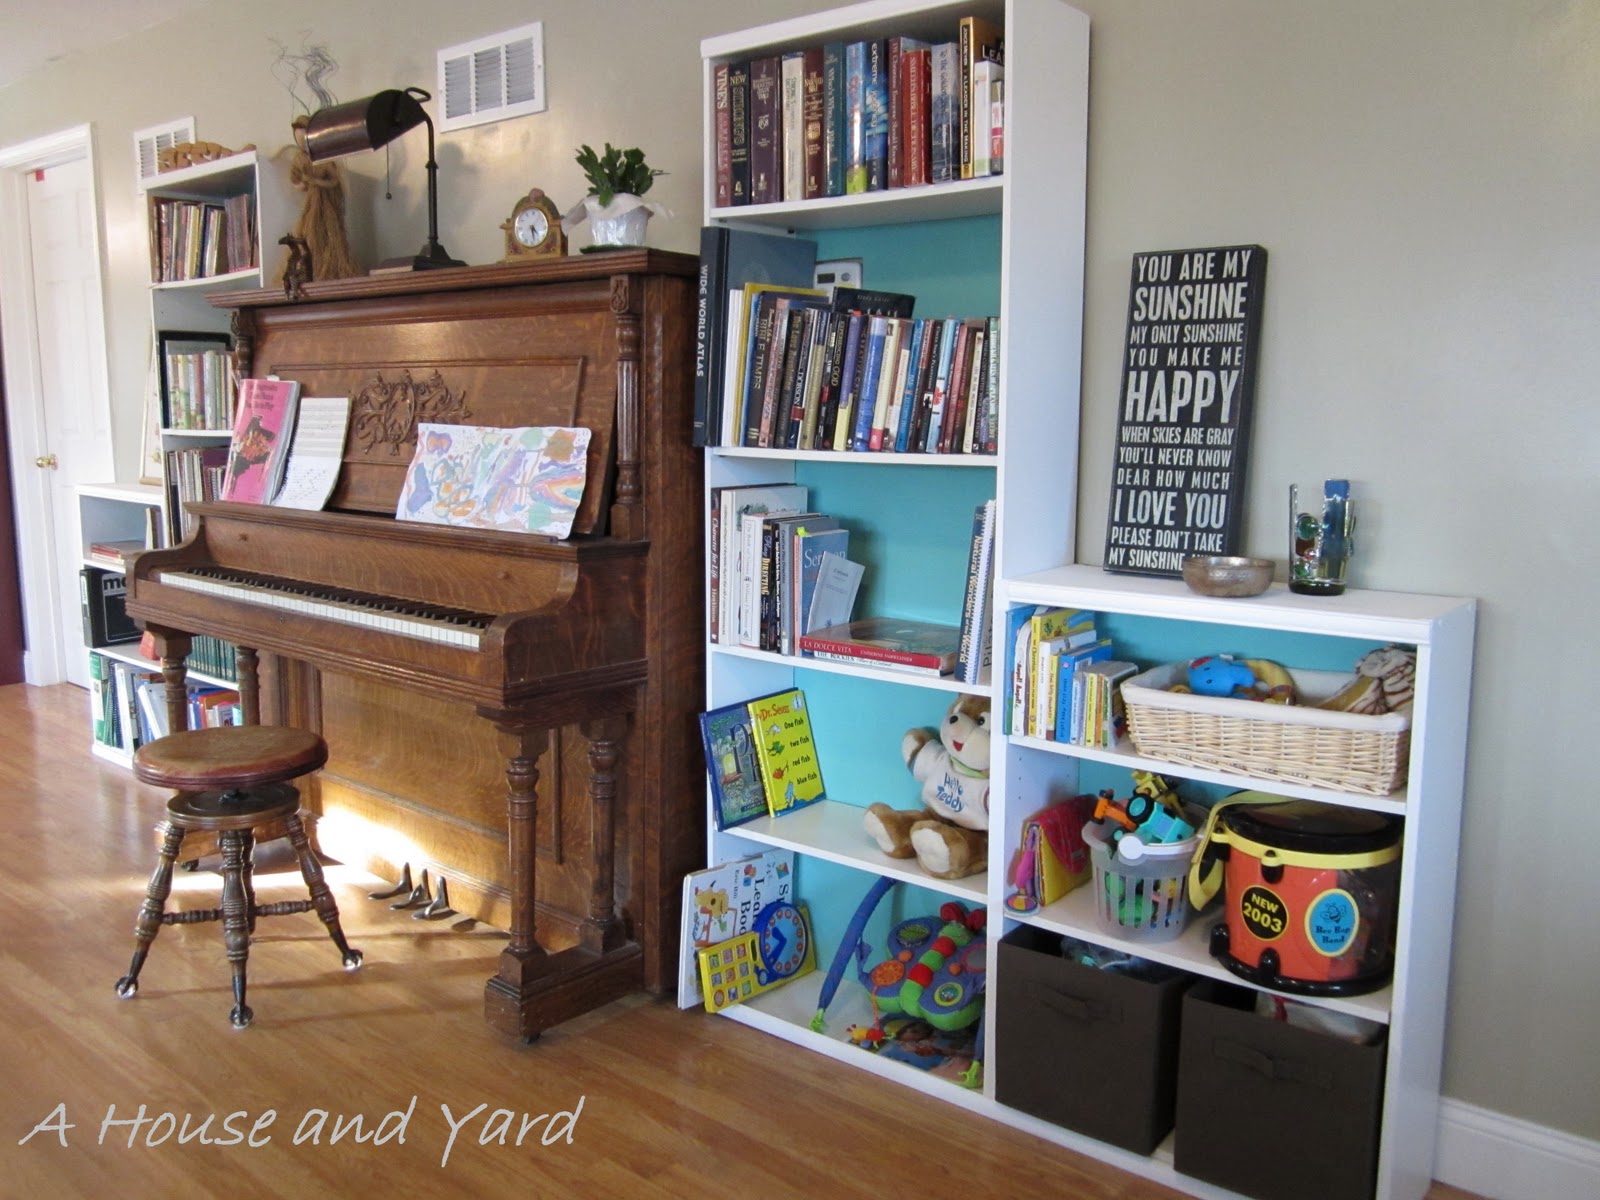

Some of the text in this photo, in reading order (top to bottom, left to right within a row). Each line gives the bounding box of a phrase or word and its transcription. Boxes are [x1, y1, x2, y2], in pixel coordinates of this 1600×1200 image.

[871, 43, 879, 86] extreme
[716, 68, 728, 110] VINE'S
[730, 74, 747, 86] NEW
[870, 90, 881, 129] journey
[891, 90, 899, 120] Everyone
[963, 111, 969, 119] IN
[1138, 249, 1252, 282] YOU ARE MY
[1133, 282, 1248, 322] SUNSHINE
[696, 265, 708, 377] WIDE WORLD ATLAS
[1130, 322, 1244, 345] MY ONLY SUNSHINE
[757, 319, 767, 350] BIBLE
[790, 330, 800, 348] Love
[831, 321, 845, 387] EXPERIENCING GOD
[1129, 346, 1242, 367] YOU MAKE ME
[753, 354, 764, 389] TIMES
[784, 351, 798, 391] Revolution
[794, 370, 804, 405] DOBSON
[1124, 370, 1240, 424] HAPPY
[1121, 426, 1234, 446] WHEN SKIES ARE GRAY
[1119, 447, 1232, 468] YOU'LL NEVER KNOW
[1117, 468, 1230, 491] DEAR HOW MUCH
[1113, 488, 1227, 529] I LOVE YOU
[711, 517, 719, 551] Character
[763, 536, 772, 557] Play
[1111, 526, 1223, 553] PLEASE DON'T TAKE
[970, 535, 983, 574] Natural
[1109, 547, 1184, 571] MY SUNSHINE
[761, 557, 771, 596] DIRECTING
[965, 575, 978, 618] Wonders
[814, 643, 836, 652] DOLCE
[830, 653, 855, 661] ROCKIES
[959, 634, 971, 663] World
[760, 704, 790, 721] Dr. Seuss
[784, 718, 804, 730] One fish
[790, 736, 809, 748] two fish
[792, 755, 810, 766] red fish
[797, 772, 817, 785] blue fish
[944, 772, 963, 795] Hello
[936, 786, 964, 812] Teddy
[1251, 893, 1279, 913] NEW
[1243, 902, 1282, 933] 2003
[1316, 925, 1332, 934] Bee
